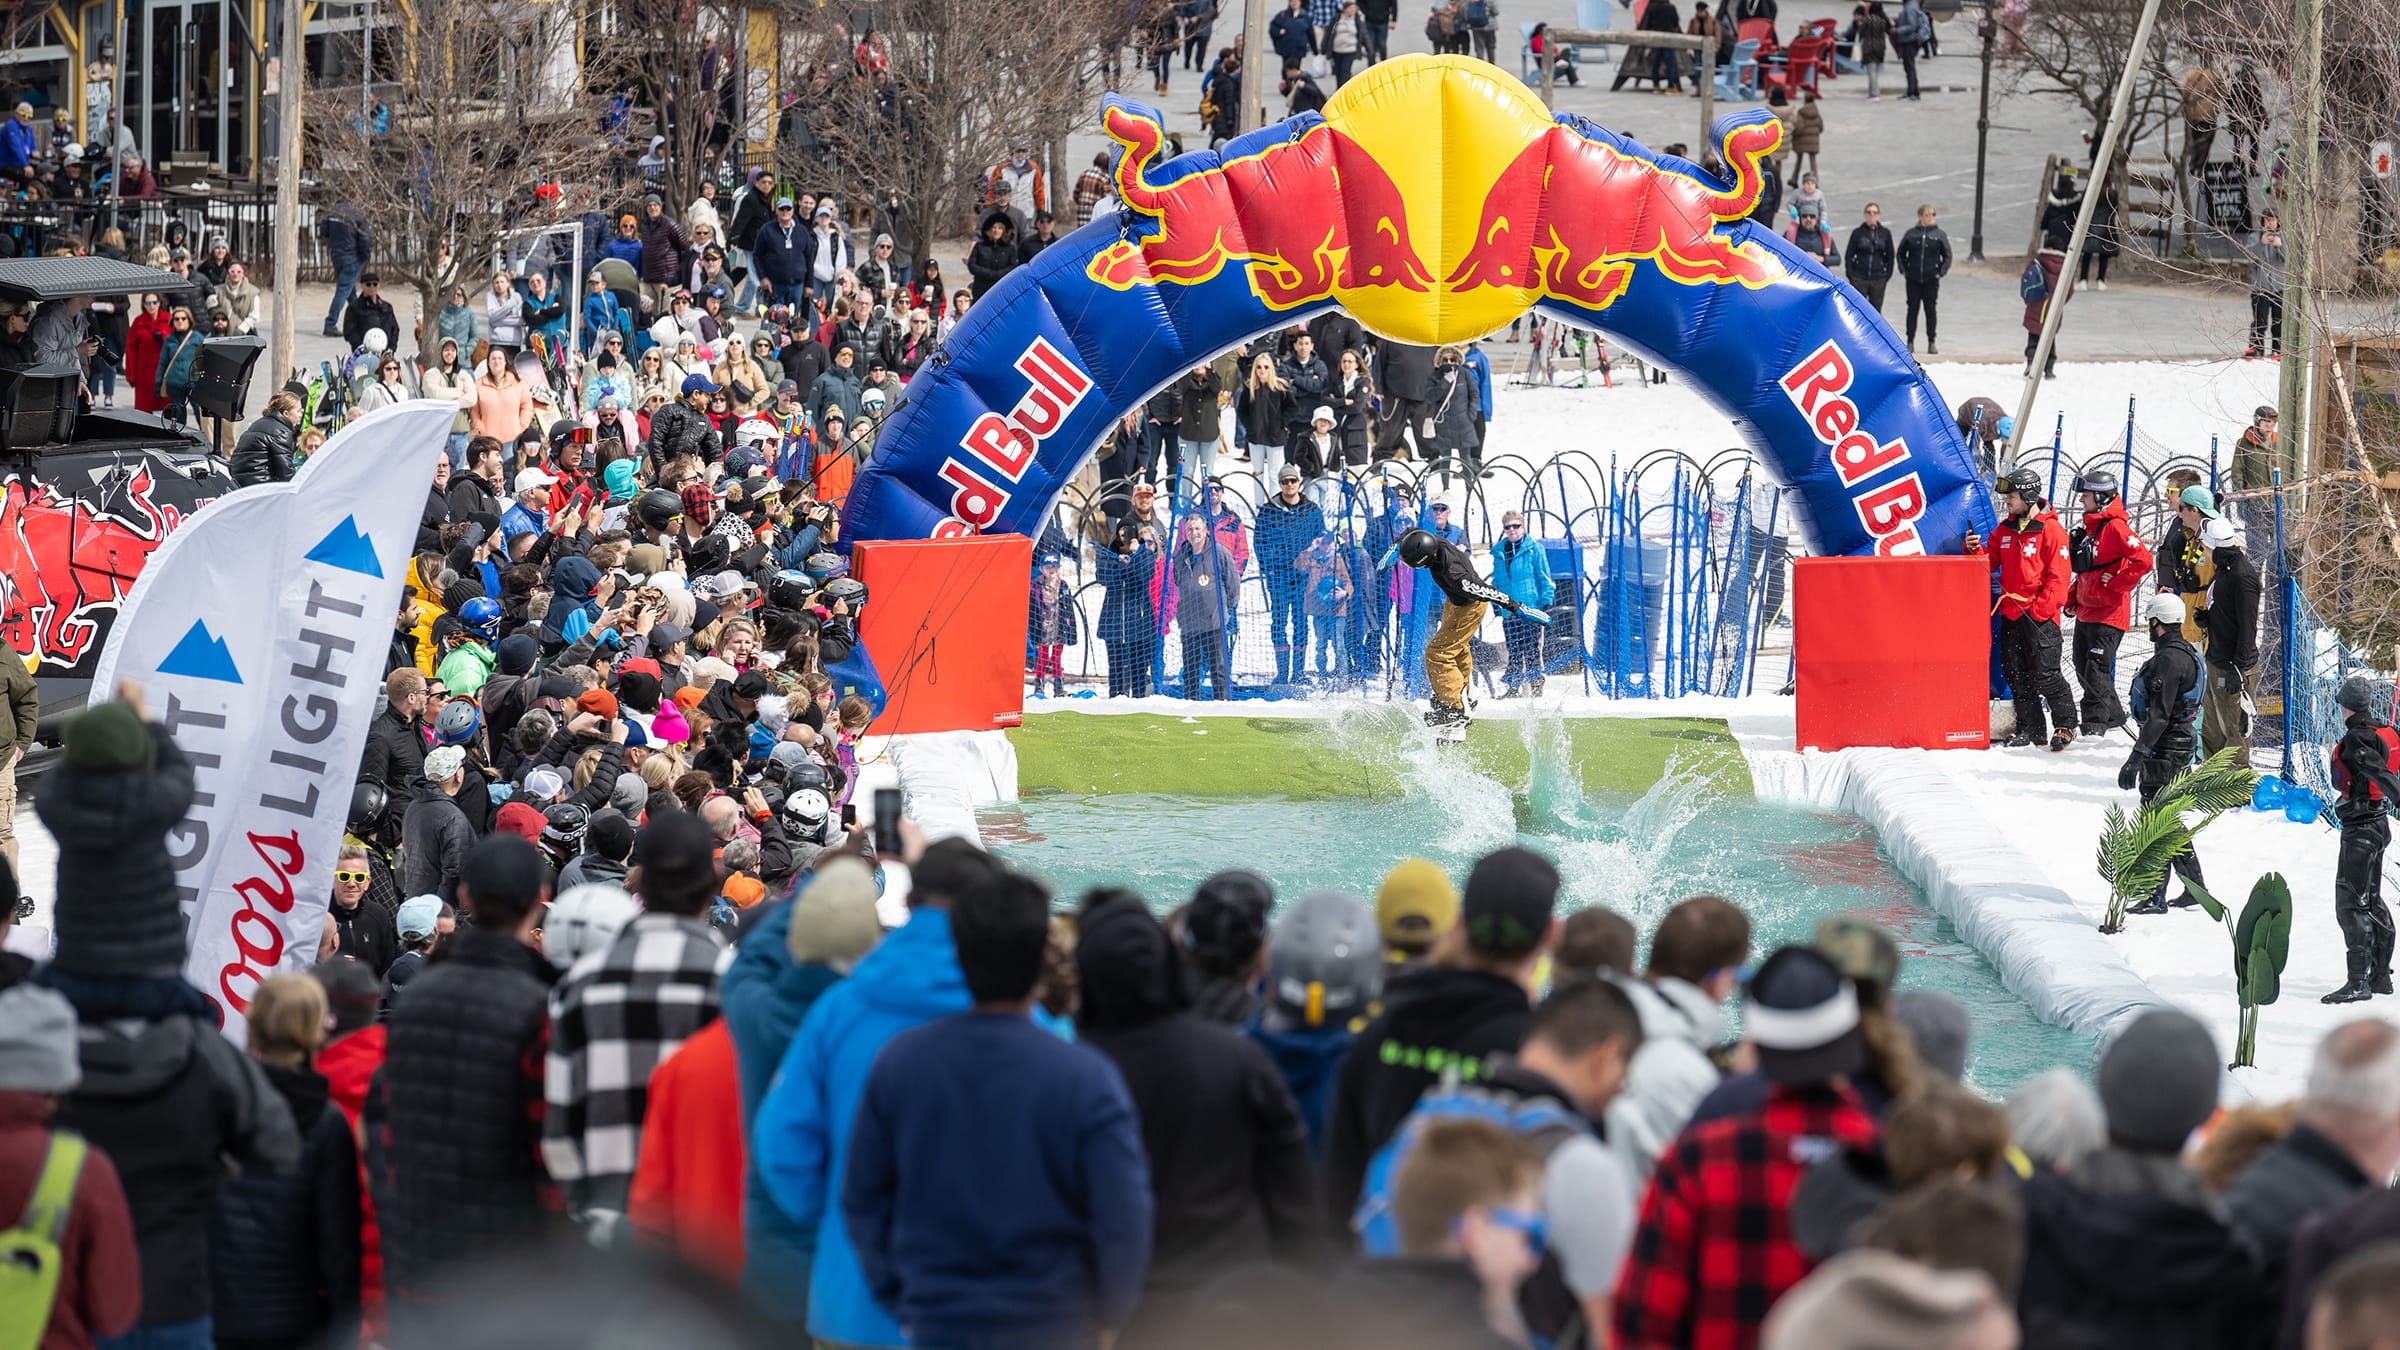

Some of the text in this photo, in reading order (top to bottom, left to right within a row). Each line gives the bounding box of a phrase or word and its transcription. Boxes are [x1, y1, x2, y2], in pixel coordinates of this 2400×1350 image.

[2213, 191, 2242, 204] SAVE
[961, 337, 1093, 483] Bull
[1780, 340, 1926, 557] Red Bu
[2014, 480, 2042, 490] VECTO
[163, 691, 227, 942] GHT
[200, 578, 366, 1033] oors LIGHT
